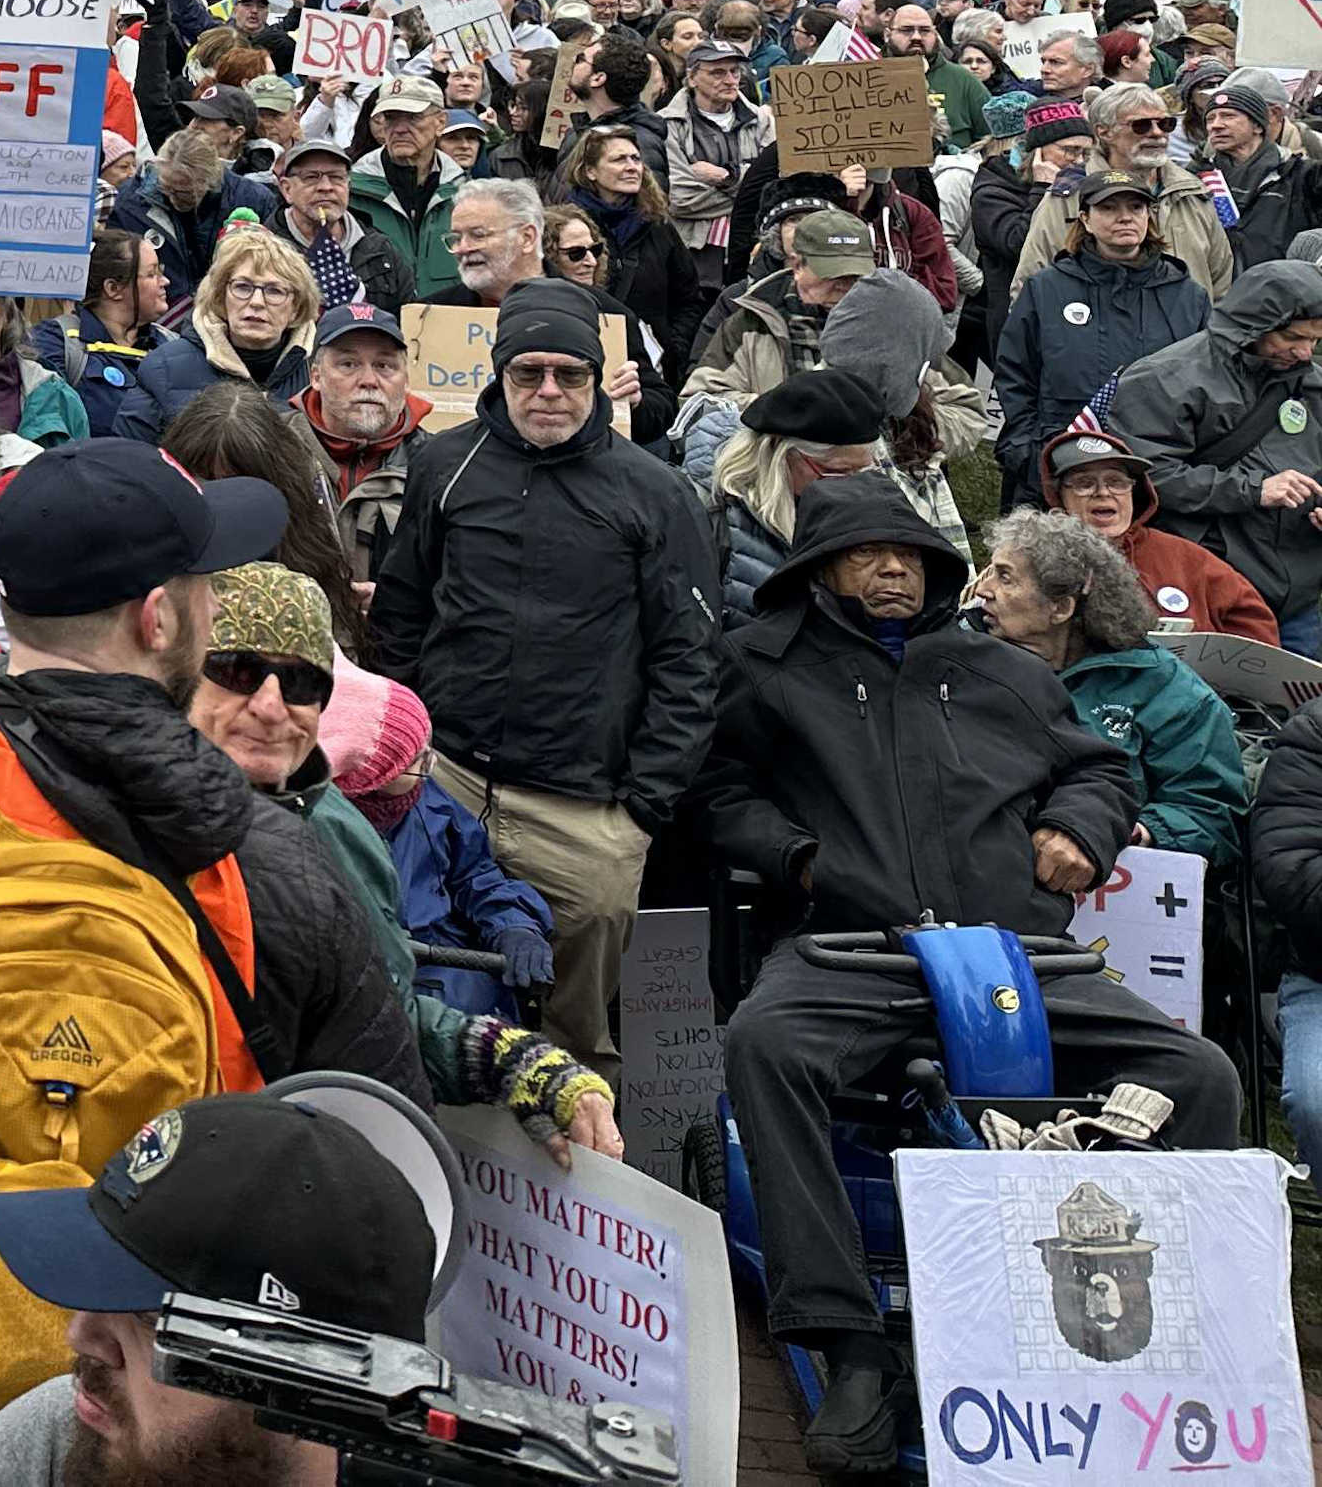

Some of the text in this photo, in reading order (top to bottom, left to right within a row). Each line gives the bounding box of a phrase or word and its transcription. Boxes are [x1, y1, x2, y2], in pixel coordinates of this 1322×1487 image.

[390, 80, 403, 96] B
[774, 64, 888, 99] NO ONE
[807, 87, 914, 116] ILLEGAL
[794, 121, 906, 153] STOLEN
[827, 149, 879, 169] LAND
[43, 171, 91, 188] CARE
[1197, 634, 1268, 676] We
[30, 1049, 104, 1068] GREGORY
[458, 1149, 669, 1281] YOU MATTER!
[546, 1256, 609, 1317] YOU
[618, 1287, 670, 1343] DO
[484, 1277, 640, 1390] MATTERS!
[495, 1337, 558, 1402] YOU
[938, 1385, 1270, 1472] ONLY YOU
